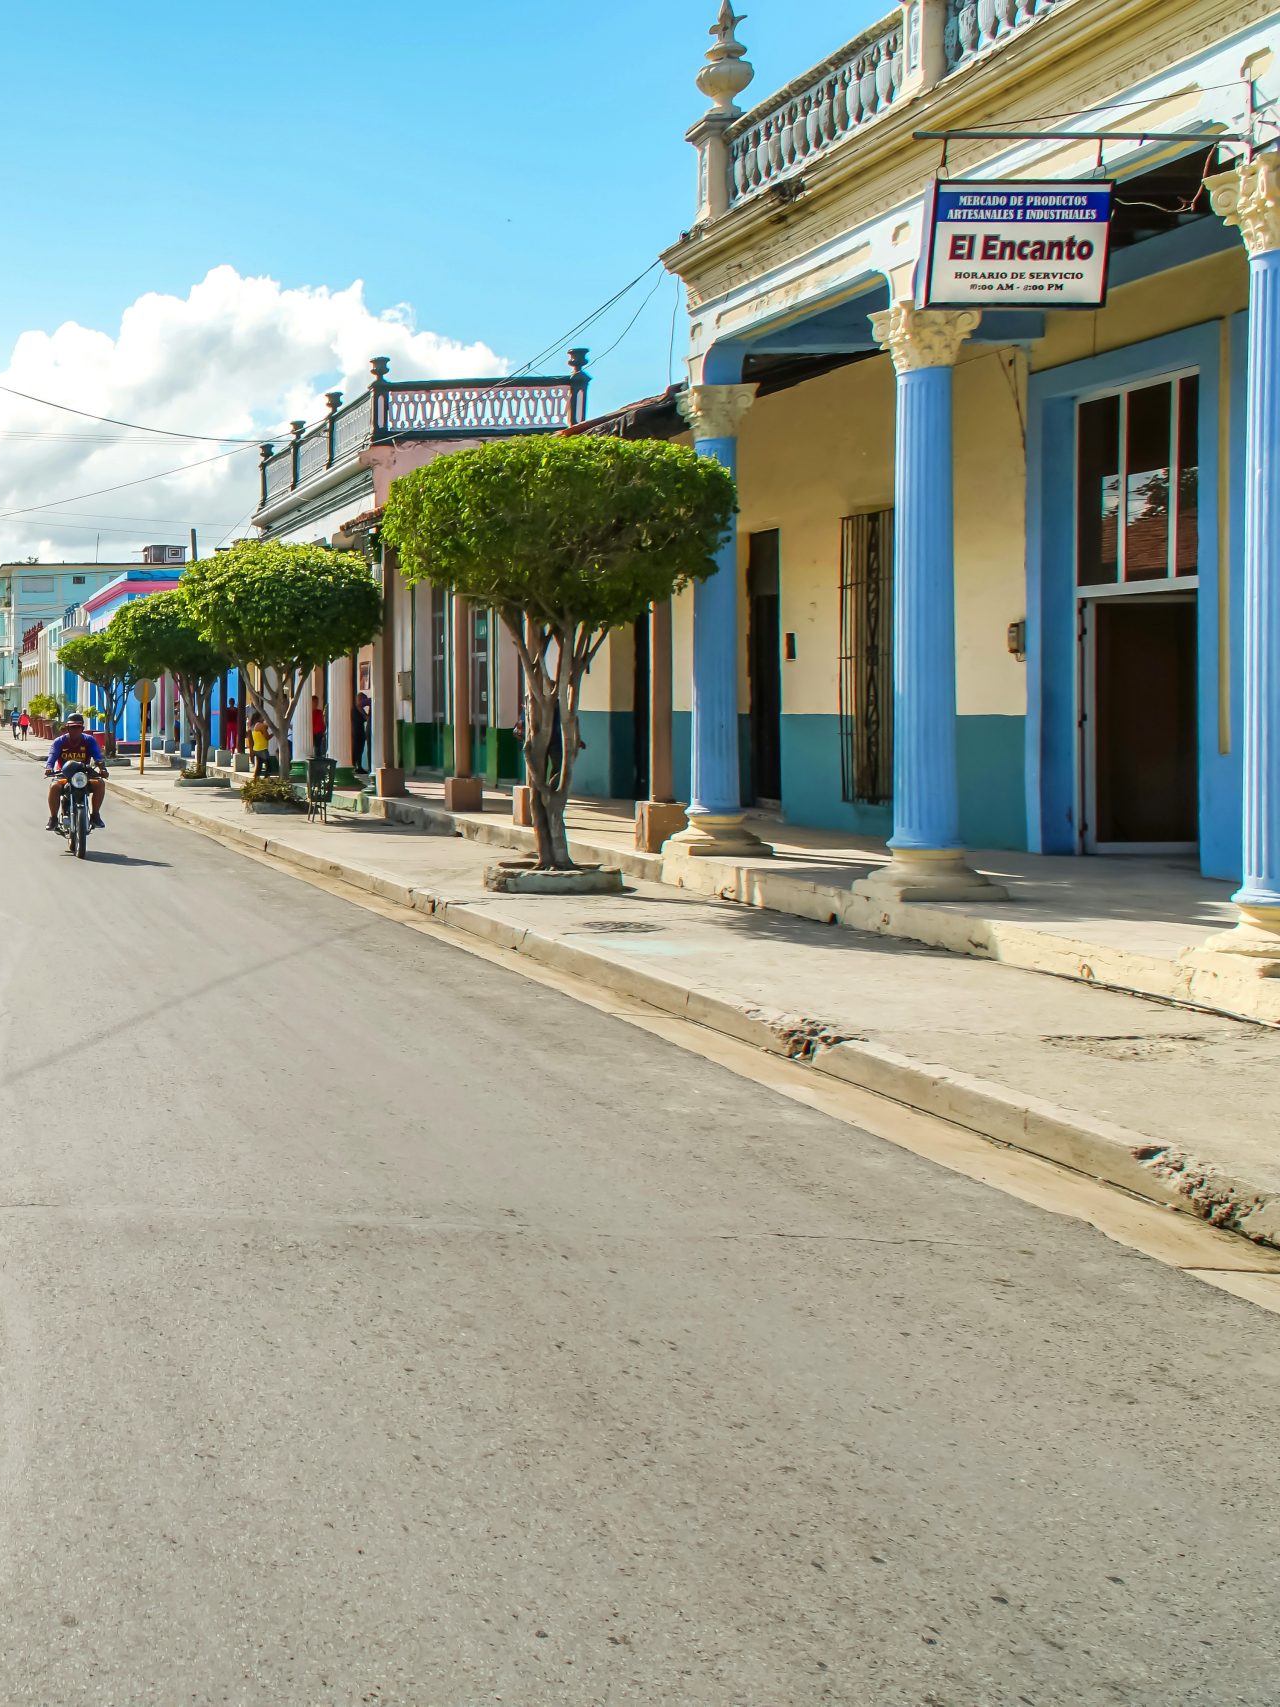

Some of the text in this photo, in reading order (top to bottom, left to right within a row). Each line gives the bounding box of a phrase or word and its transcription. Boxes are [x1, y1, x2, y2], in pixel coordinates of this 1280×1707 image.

[959, 195, 1088, 206] MERCADO DE PRODUCTOS
[947, 209, 1097, 220] ARTESANALES E INDUSTRIALES
[948, 234, 1094, 261] El Encanto
[954, 271, 1084, 280] HORARIO DE SERVICIO
[996, 283, 1015, 291] AM
[1046, 283, 1064, 291] PM
[61, 752, 86, 760] QATAR
